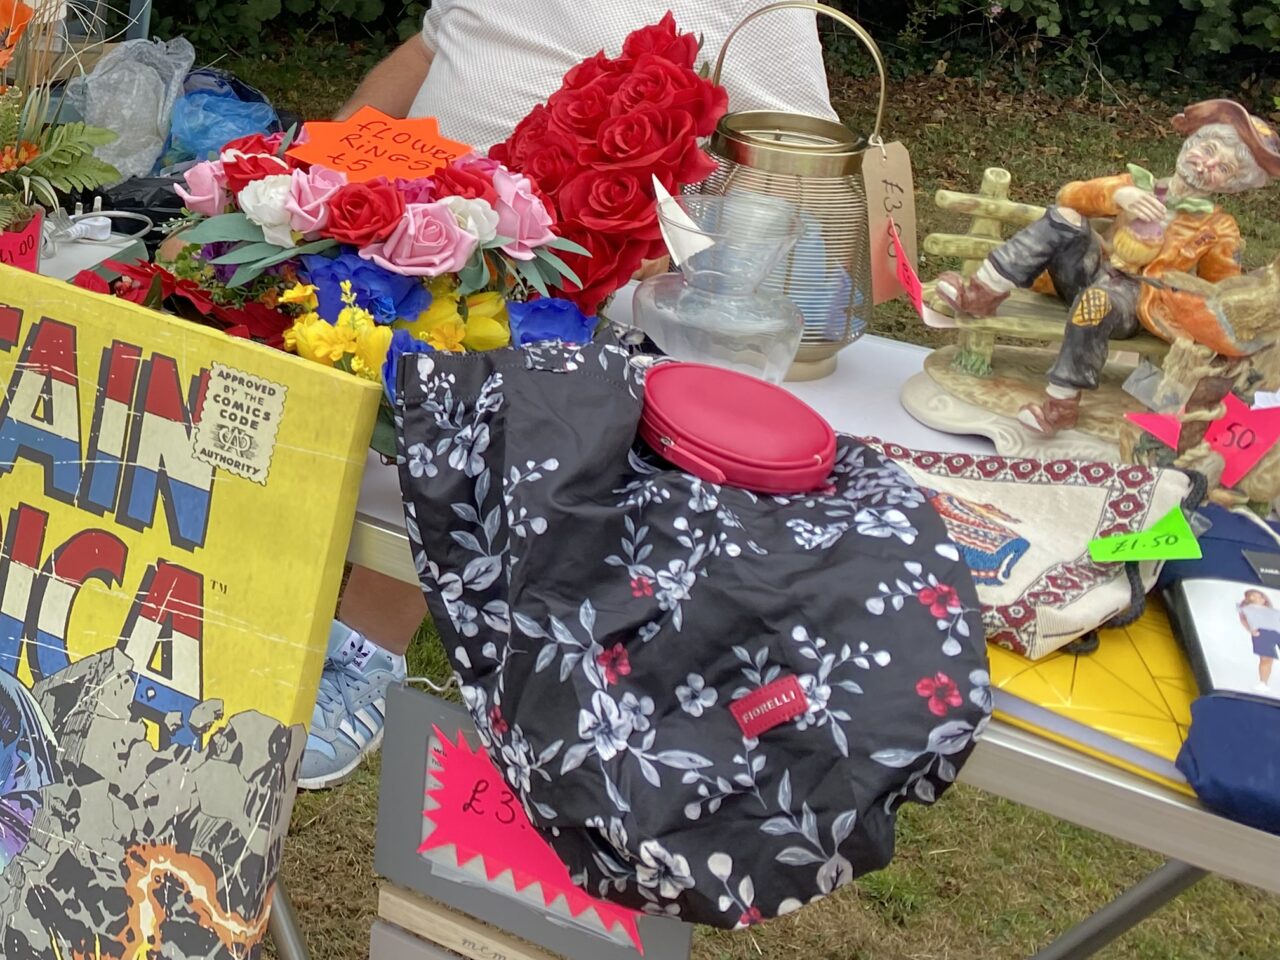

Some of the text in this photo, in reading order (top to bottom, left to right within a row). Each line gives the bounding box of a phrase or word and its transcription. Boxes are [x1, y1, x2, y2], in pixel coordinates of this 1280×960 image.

[217, 370, 277, 397] APPROVED
[223, 384, 265, 406] BY THE
[212, 393, 272, 422] COMICS
[219, 409, 260, 431] CODE
[200, 447, 261, 476] AUTHORITY
[1111, 533, 1179, 555] £1.50
[742, 690, 797, 724] FIORELLI
